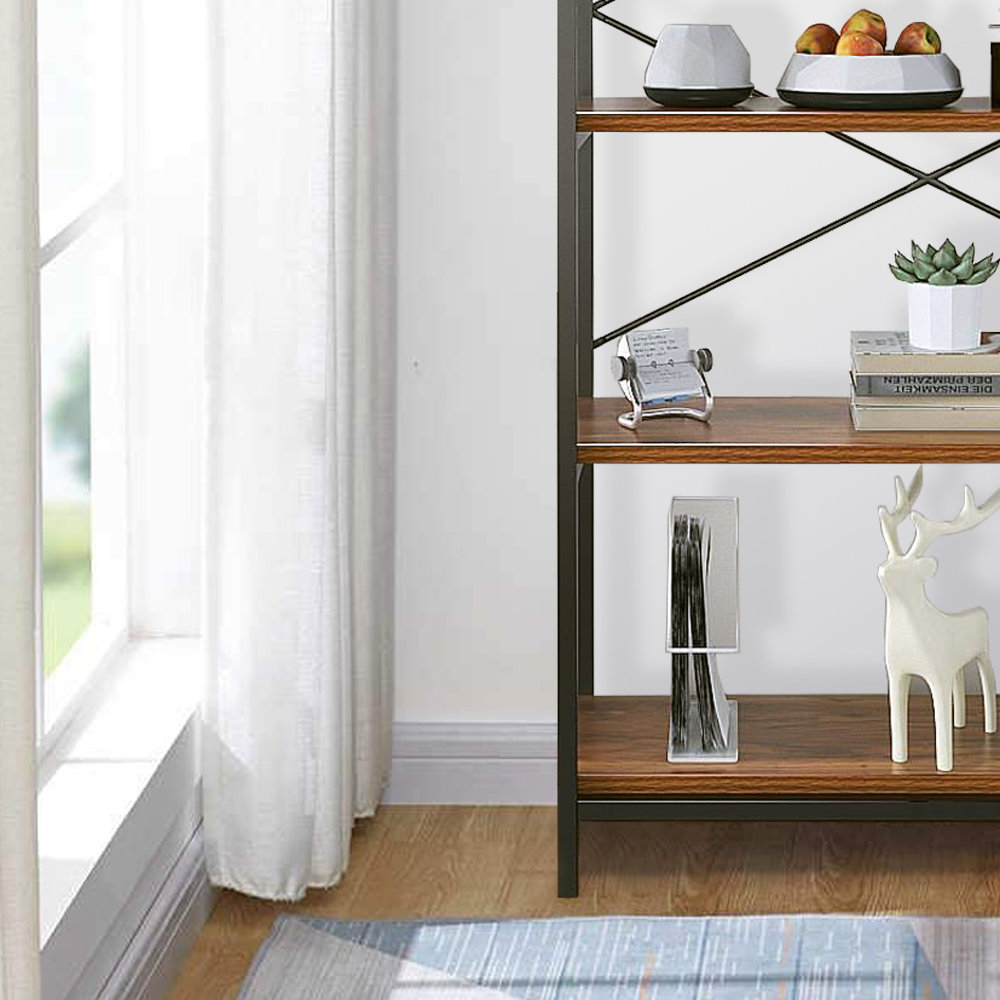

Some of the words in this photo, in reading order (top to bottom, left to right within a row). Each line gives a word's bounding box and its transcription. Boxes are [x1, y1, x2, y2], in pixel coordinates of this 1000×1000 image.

[883, 375, 961, 384] PRIMZAHLEN
[968, 375, 993, 384] DER
[895, 385, 968, 393] EINSAMKEIT
[972, 385, 993, 393] DIE
